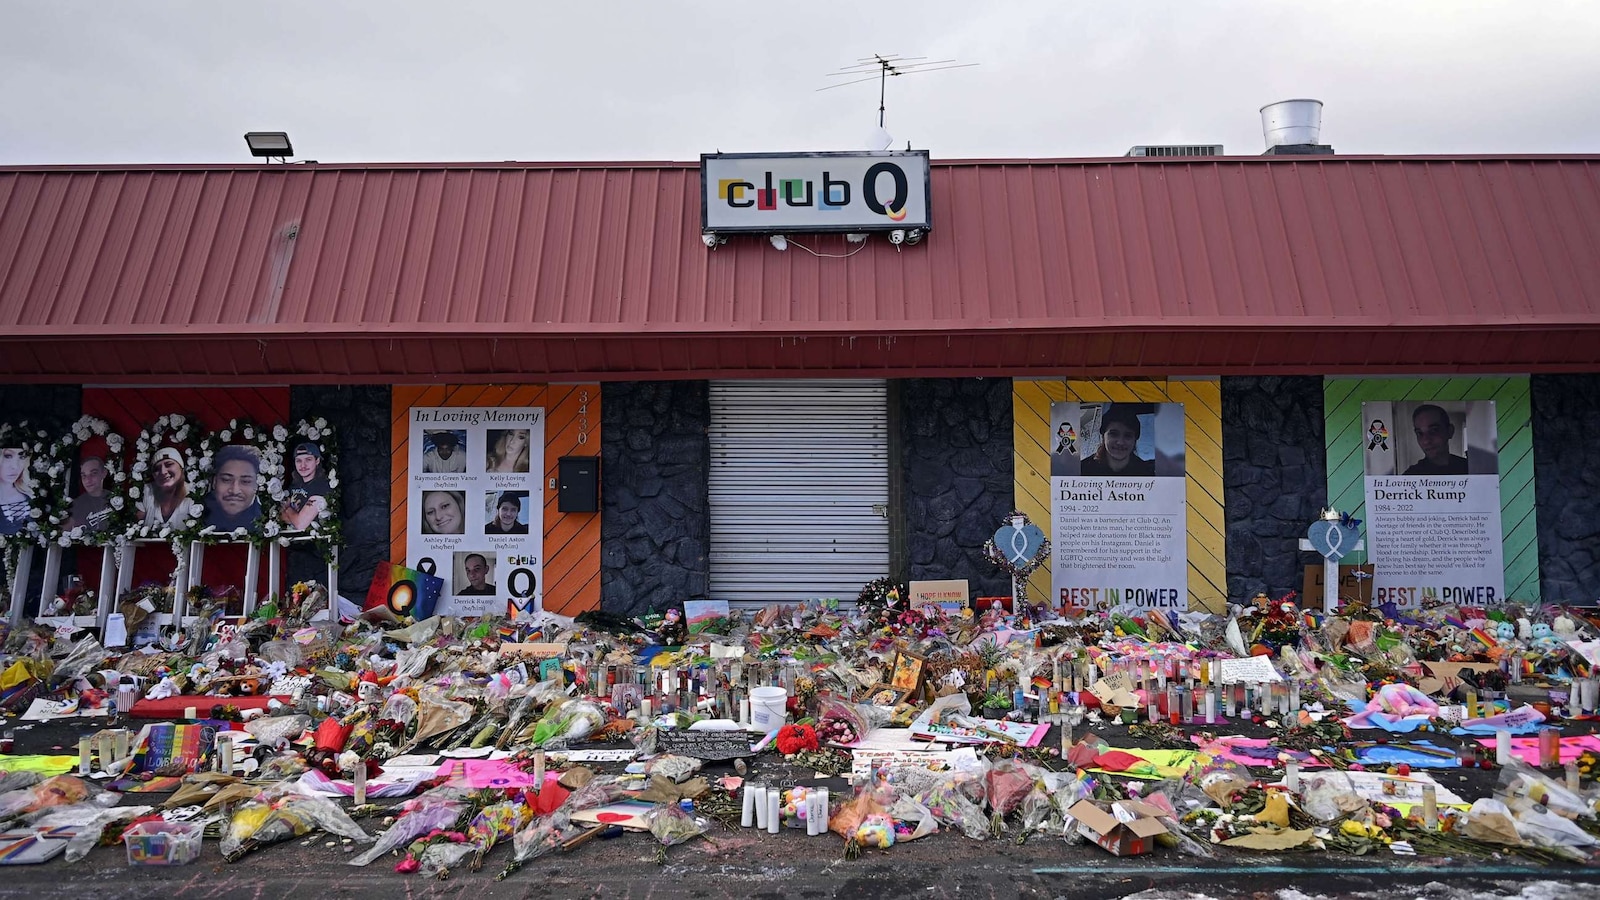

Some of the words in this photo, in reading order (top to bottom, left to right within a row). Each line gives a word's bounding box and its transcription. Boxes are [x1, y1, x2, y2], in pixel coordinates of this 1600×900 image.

[727, 171, 851, 207] club
[863, 162, 908, 221] Q
[416, 410, 429, 421] In
[433, 410, 480, 425] Loving
[483, 410, 539, 425] Memory
[578, 391, 588, 444] 3430
[415, 475, 440, 484] Raymond
[1374, 479, 1383, 487] In
[1386, 479, 1417, 489] Loving
[1419, 479, 1456, 489] Memory
[1459, 478, 1468, 489] of
[1072, 480, 1103, 490] Loving
[1105, 480, 1143, 490] Memory
[1145, 480, 1155, 490] of
[1060, 490, 1103, 501] Daniel
[1108, 491, 1144, 501] Aston
[1375, 490, 1423, 500] Derrick
[1427, 489, 1466, 502] Rump
[1375, 516, 1395, 524] Always
[1428, 515, 1447, 523] joking,
[1060, 524, 1091, 533] outspoken
[1134, 525, 1172, 533] continuously
[1443, 522, 1475, 530] community.
[1060, 532, 1080, 541] helped
[1392, 529, 1403, 537] part
[1060, 540, 1080, 548] people
[1101, 540, 1133, 548] Instagram.
[1375, 536, 1394, 544] having
[1470, 535, 1489, 543] always
[1400, 542, 1417, 550] family
[1459, 542, 1481, 550] through
[1120, 547, 1143, 556] support
[1400, 549, 1429, 557] friendship.
[509, 554, 536, 565] club
[1061, 555, 1083, 563] LGBTQ
[1084, 555, 1118, 563] community
[1157, 555, 1171, 564] light
[1386, 556, 1401, 564] living
[1412, 556, 1431, 564] dream,
[1454, 555, 1472, 563] people
[1074, 562, 1106, 571] brightened
[508, 568, 536, 598] Q
[387, 580, 417, 617] Q
[1105, 588, 1119, 606] IN
[1378, 587, 1416, 606] REST
[55, 625, 75, 635] Love
